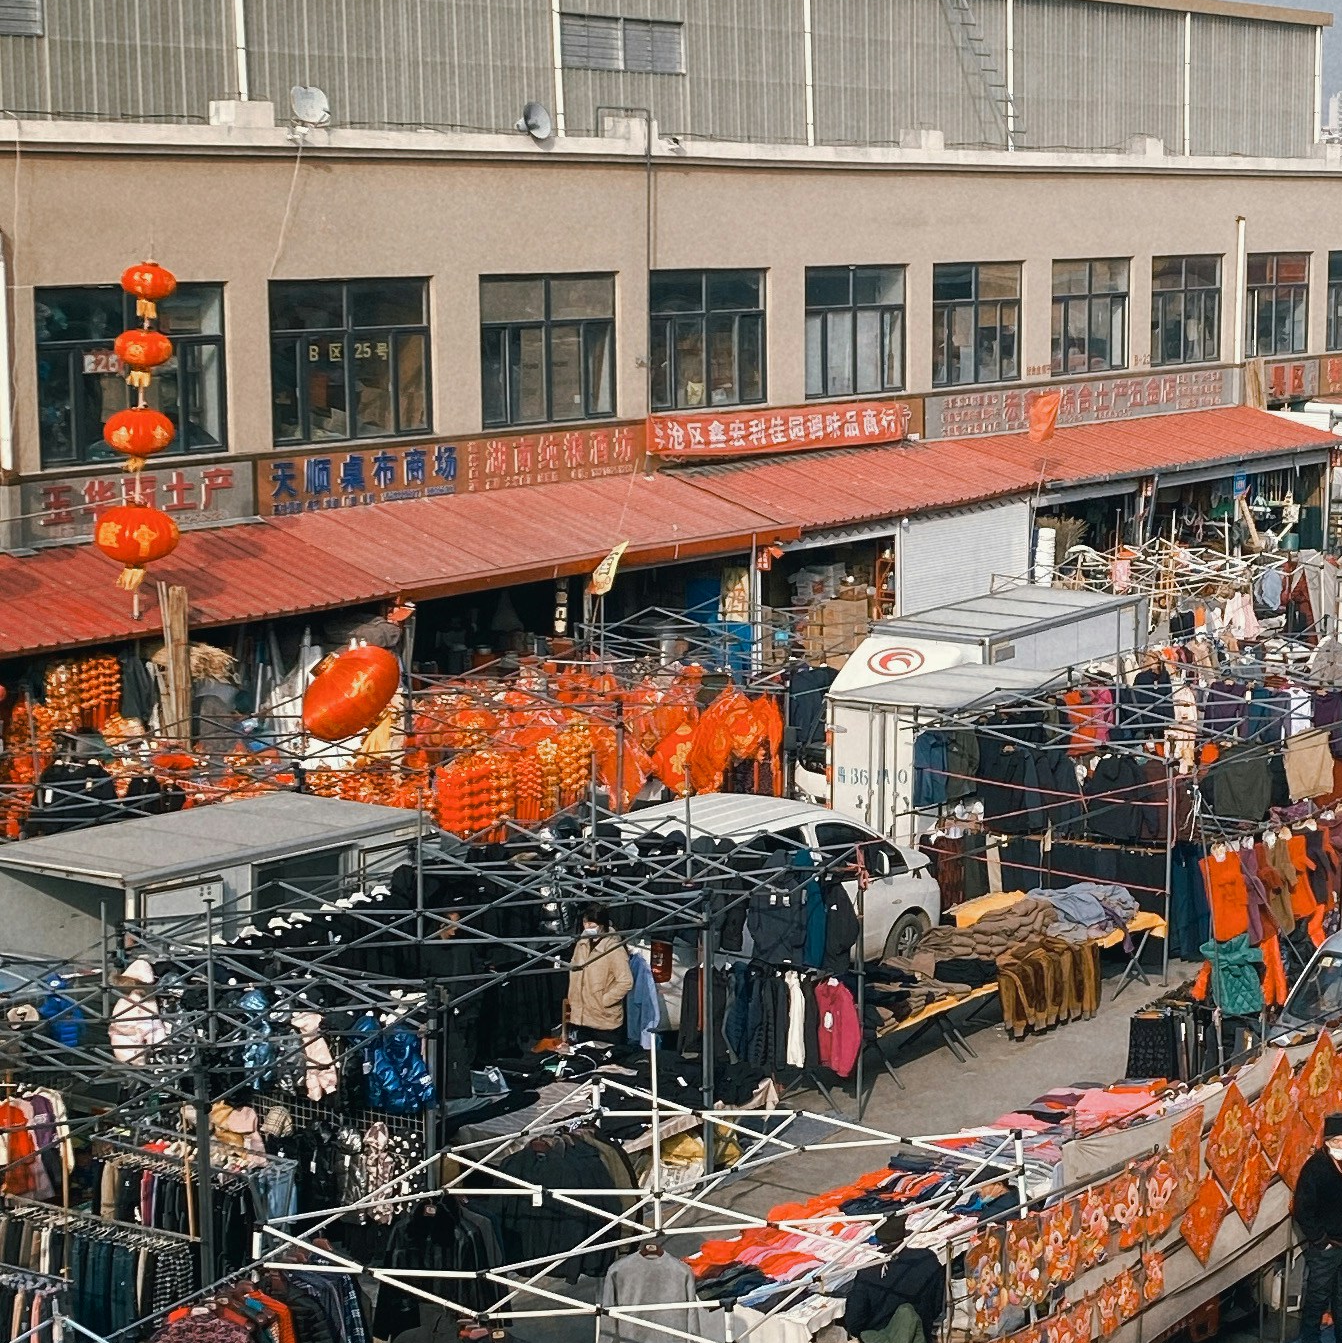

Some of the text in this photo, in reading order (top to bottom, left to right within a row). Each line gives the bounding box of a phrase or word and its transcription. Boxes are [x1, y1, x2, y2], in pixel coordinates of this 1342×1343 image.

[270, 445, 458, 499] 天顺桌布商场
